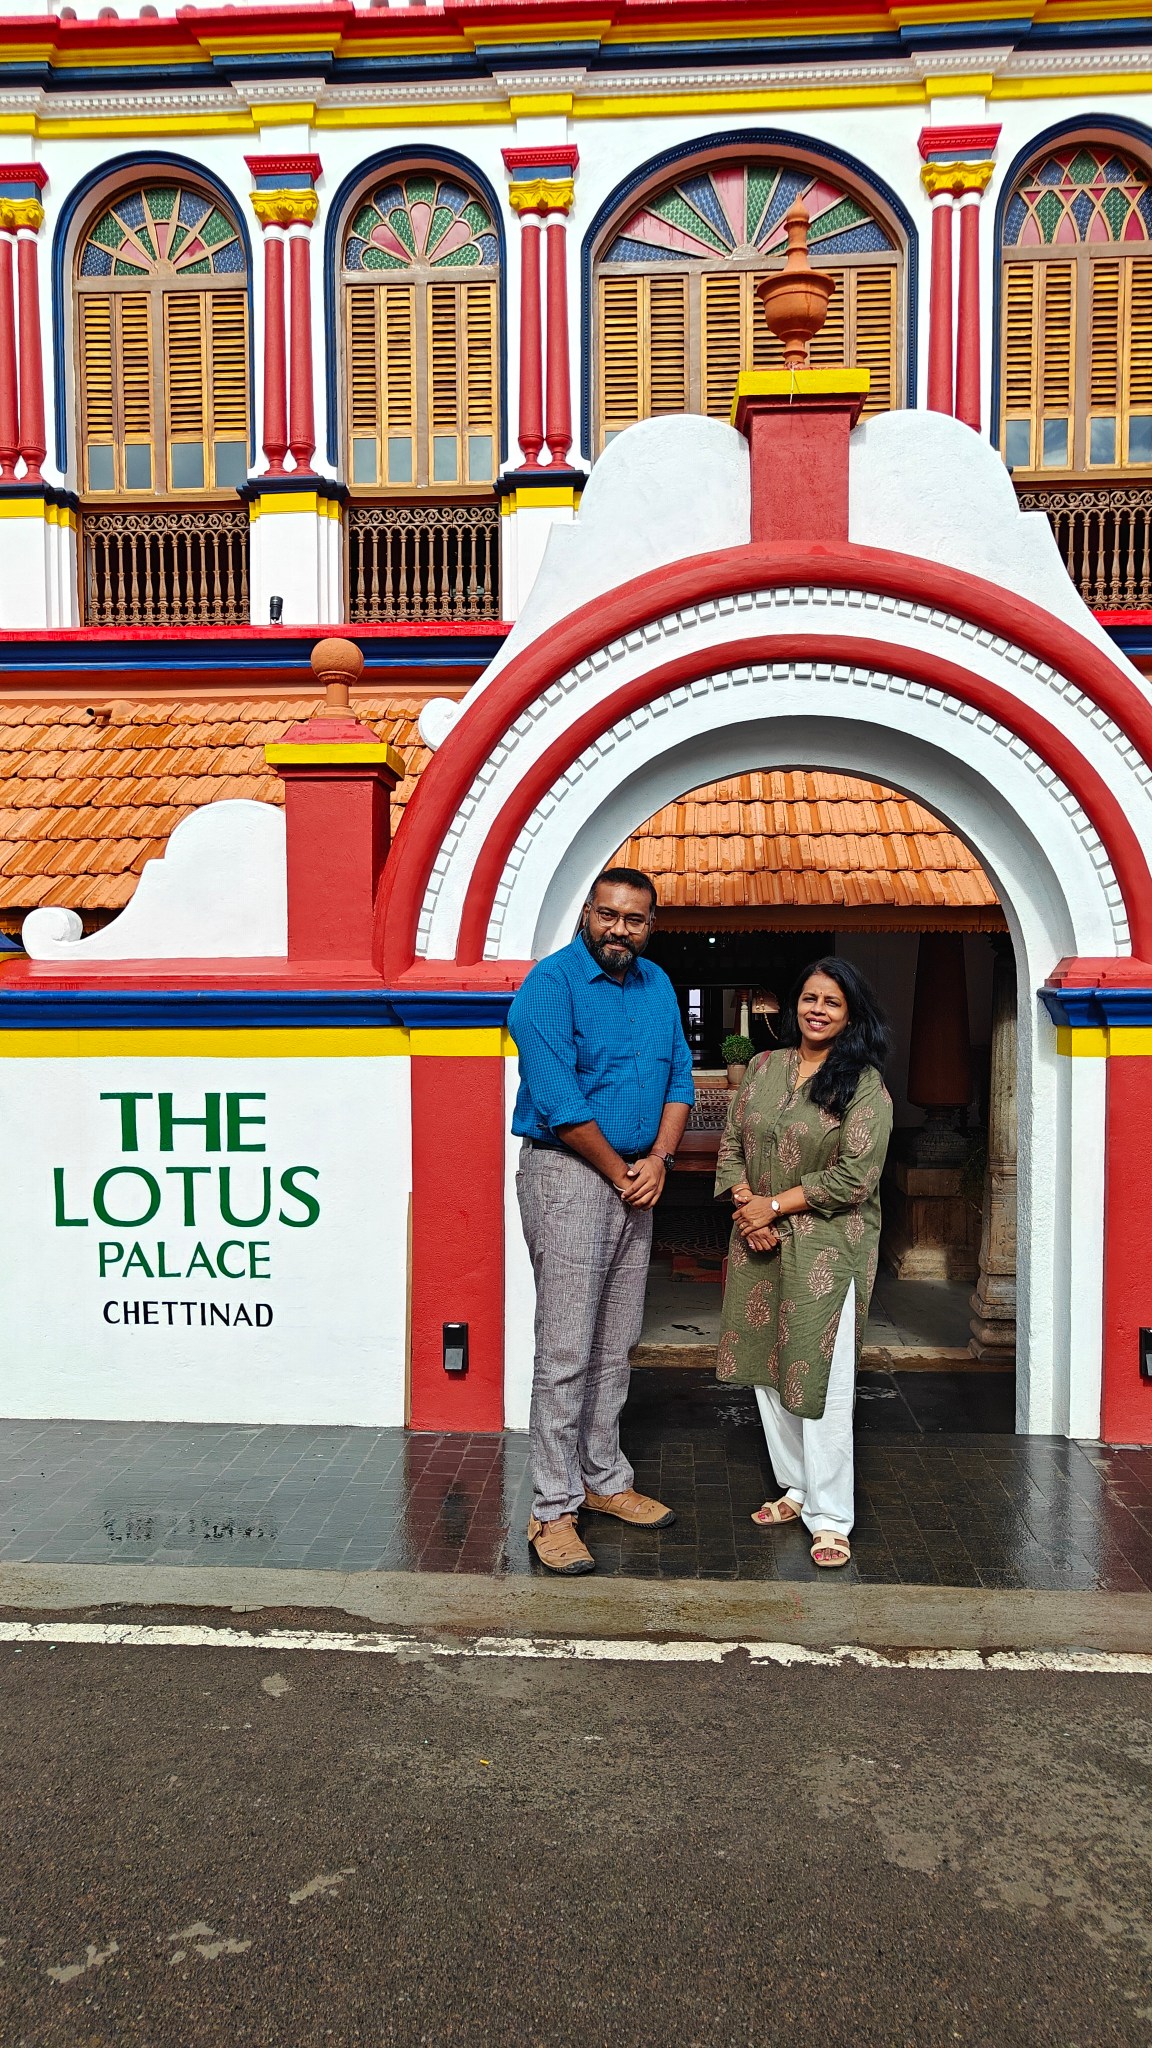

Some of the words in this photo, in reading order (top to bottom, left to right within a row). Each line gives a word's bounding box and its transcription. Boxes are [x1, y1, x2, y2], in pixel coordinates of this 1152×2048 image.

[99, 1092, 267, 1153] THE
[53, 1165, 321, 1228] LOTUS
[98, 1239, 271, 1279] PALACE
[102, 1300, 274, 1328] CHETTINAD
